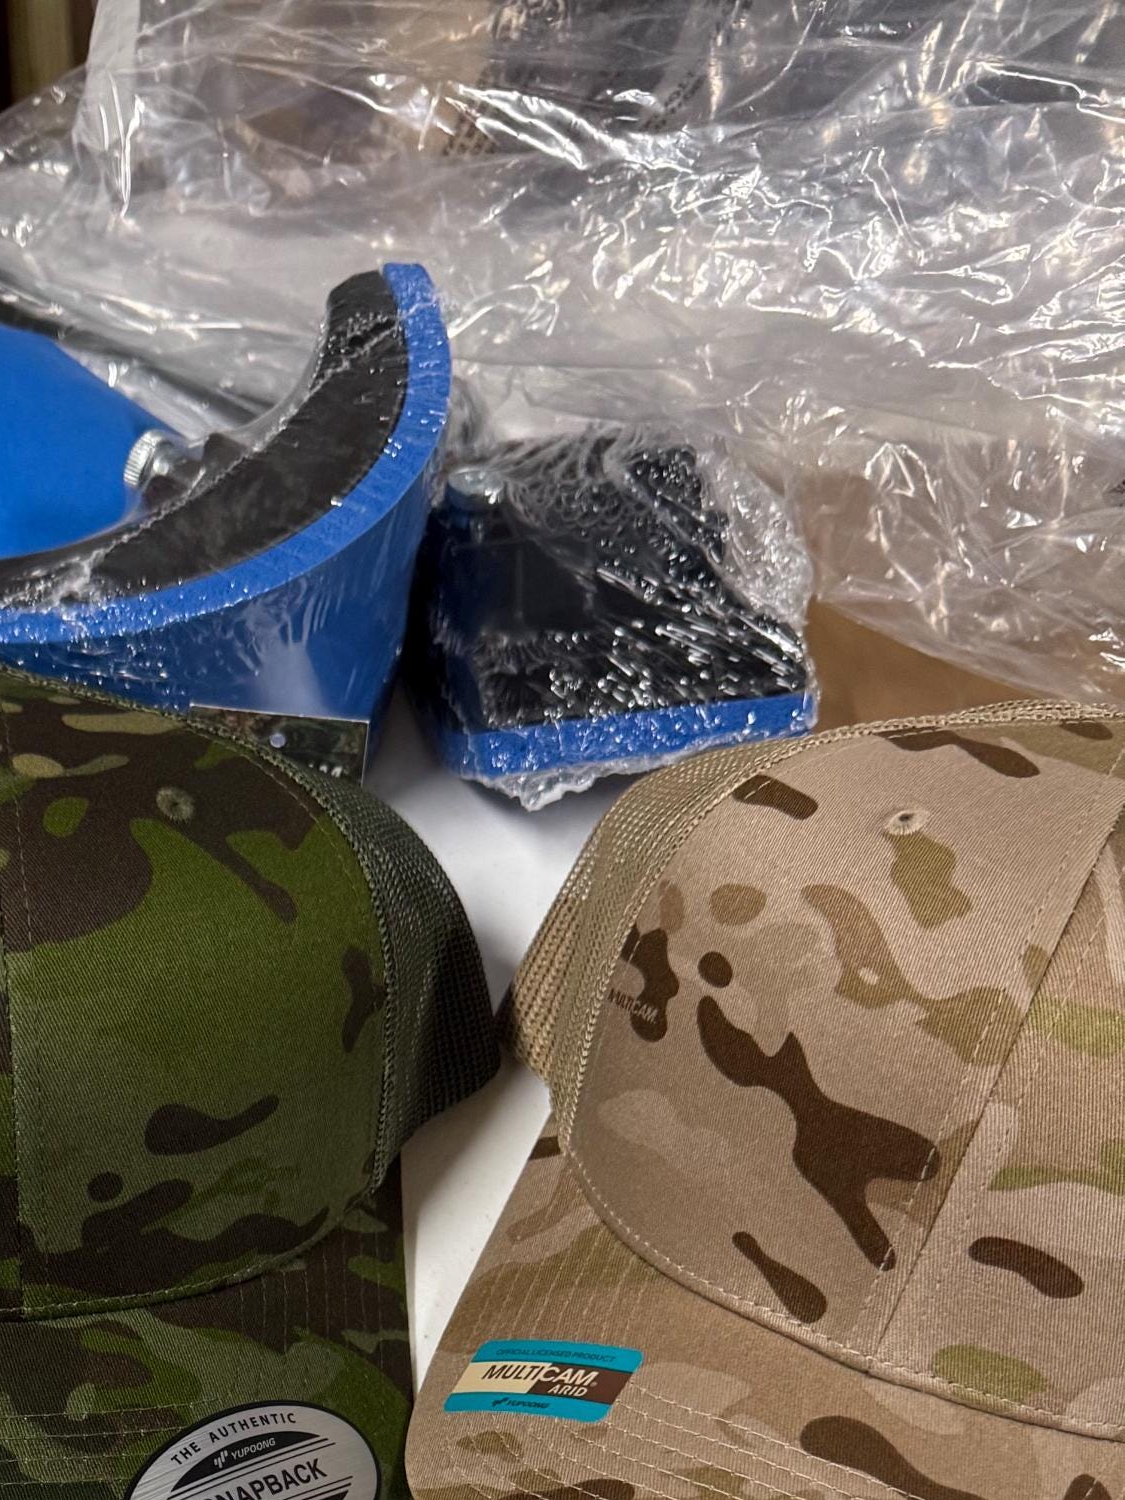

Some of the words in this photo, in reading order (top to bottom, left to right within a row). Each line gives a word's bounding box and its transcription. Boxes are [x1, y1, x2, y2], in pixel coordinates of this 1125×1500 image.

[496, 1348, 532, 1357] OFFICIAL
[533, 1349, 570, 1359] LICENSED
[571, 1351, 615, 1362] PRODUCT
[548, 1384, 588, 1397] ARID
[171, 1442, 202, 1467] THE
[208, 1412, 297, 1443] AUTHENTIC
[231, 1437, 276, 1460] YUPOONG
